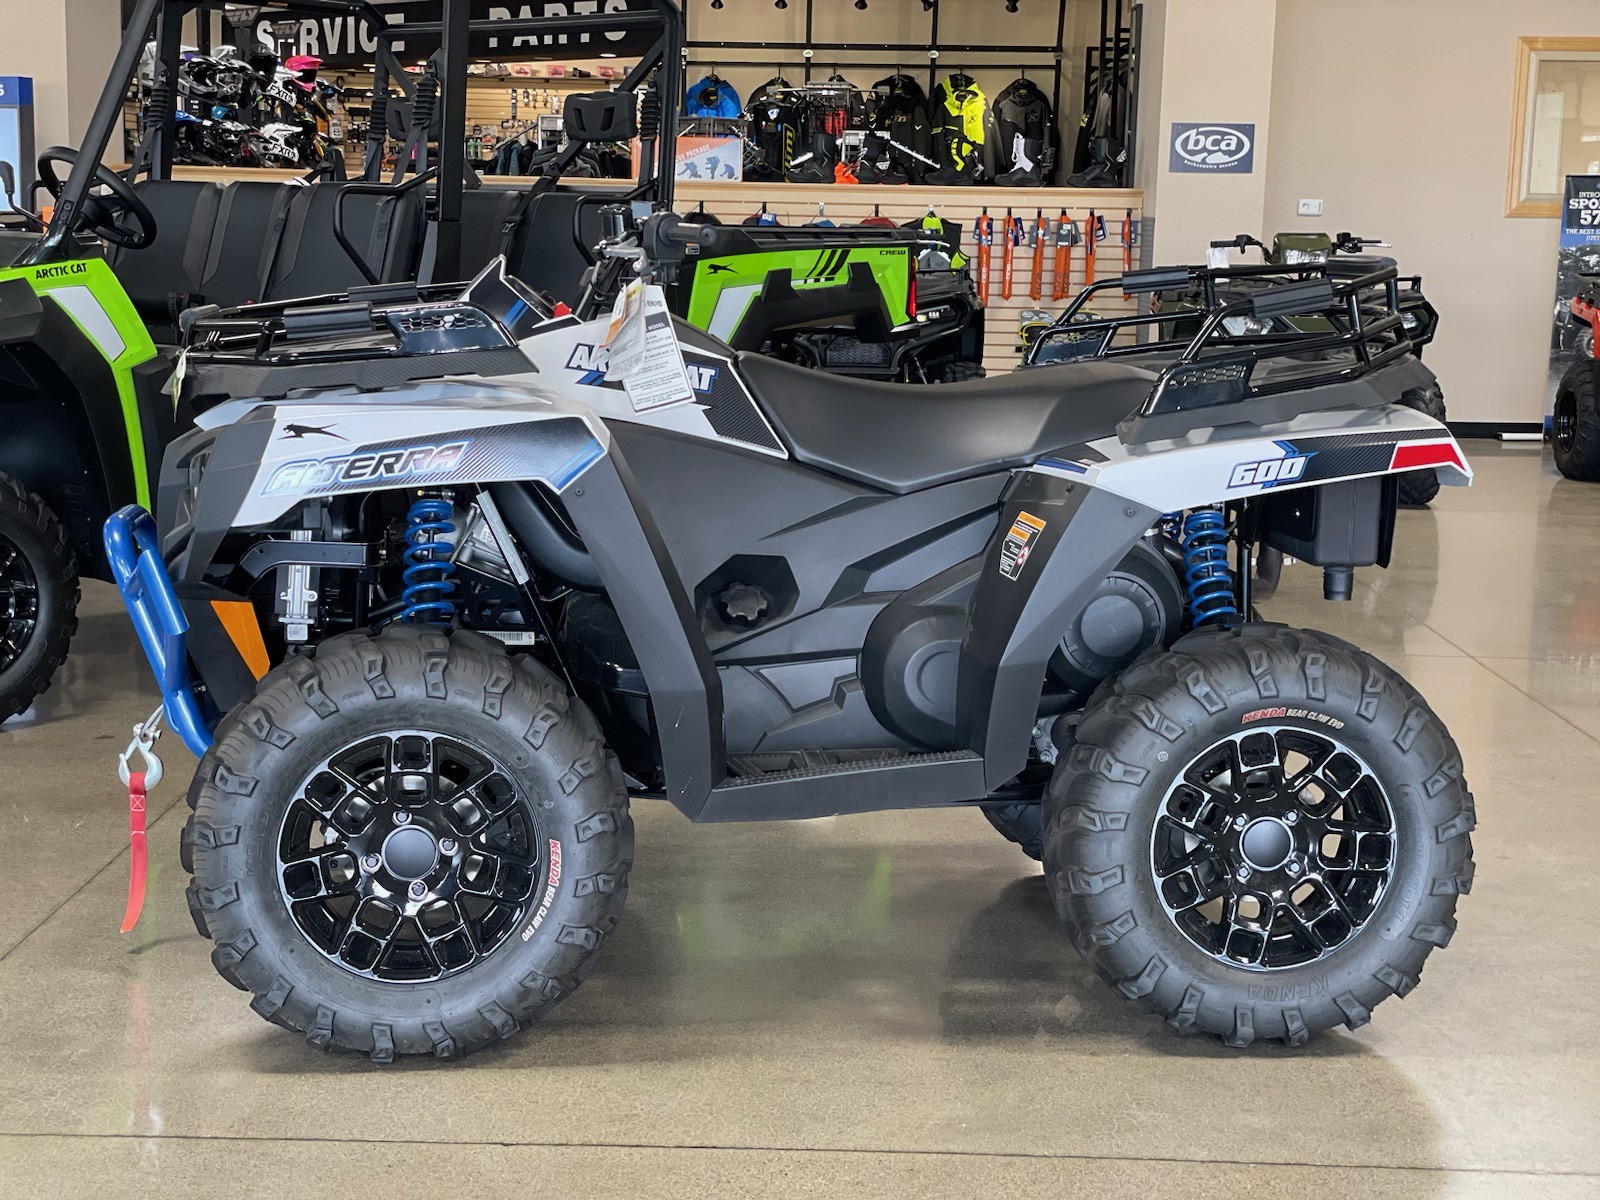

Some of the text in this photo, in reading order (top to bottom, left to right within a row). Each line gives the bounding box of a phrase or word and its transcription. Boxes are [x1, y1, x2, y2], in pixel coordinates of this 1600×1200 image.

[1187, 128, 1238, 151] bca
[1569, 198, 1600, 209] SPO
[36, 263, 87, 279] ARCTIC CAT
[263, 440, 471, 494] ALTERRA
[1229, 458, 1300, 487] 600
[1241, 707, 1345, 730] KENDA BEAR CLAW EVO
[521, 838, 562, 942] KENDA BEAR CLAW EVO
[1247, 975, 1329, 1001] KENDA
